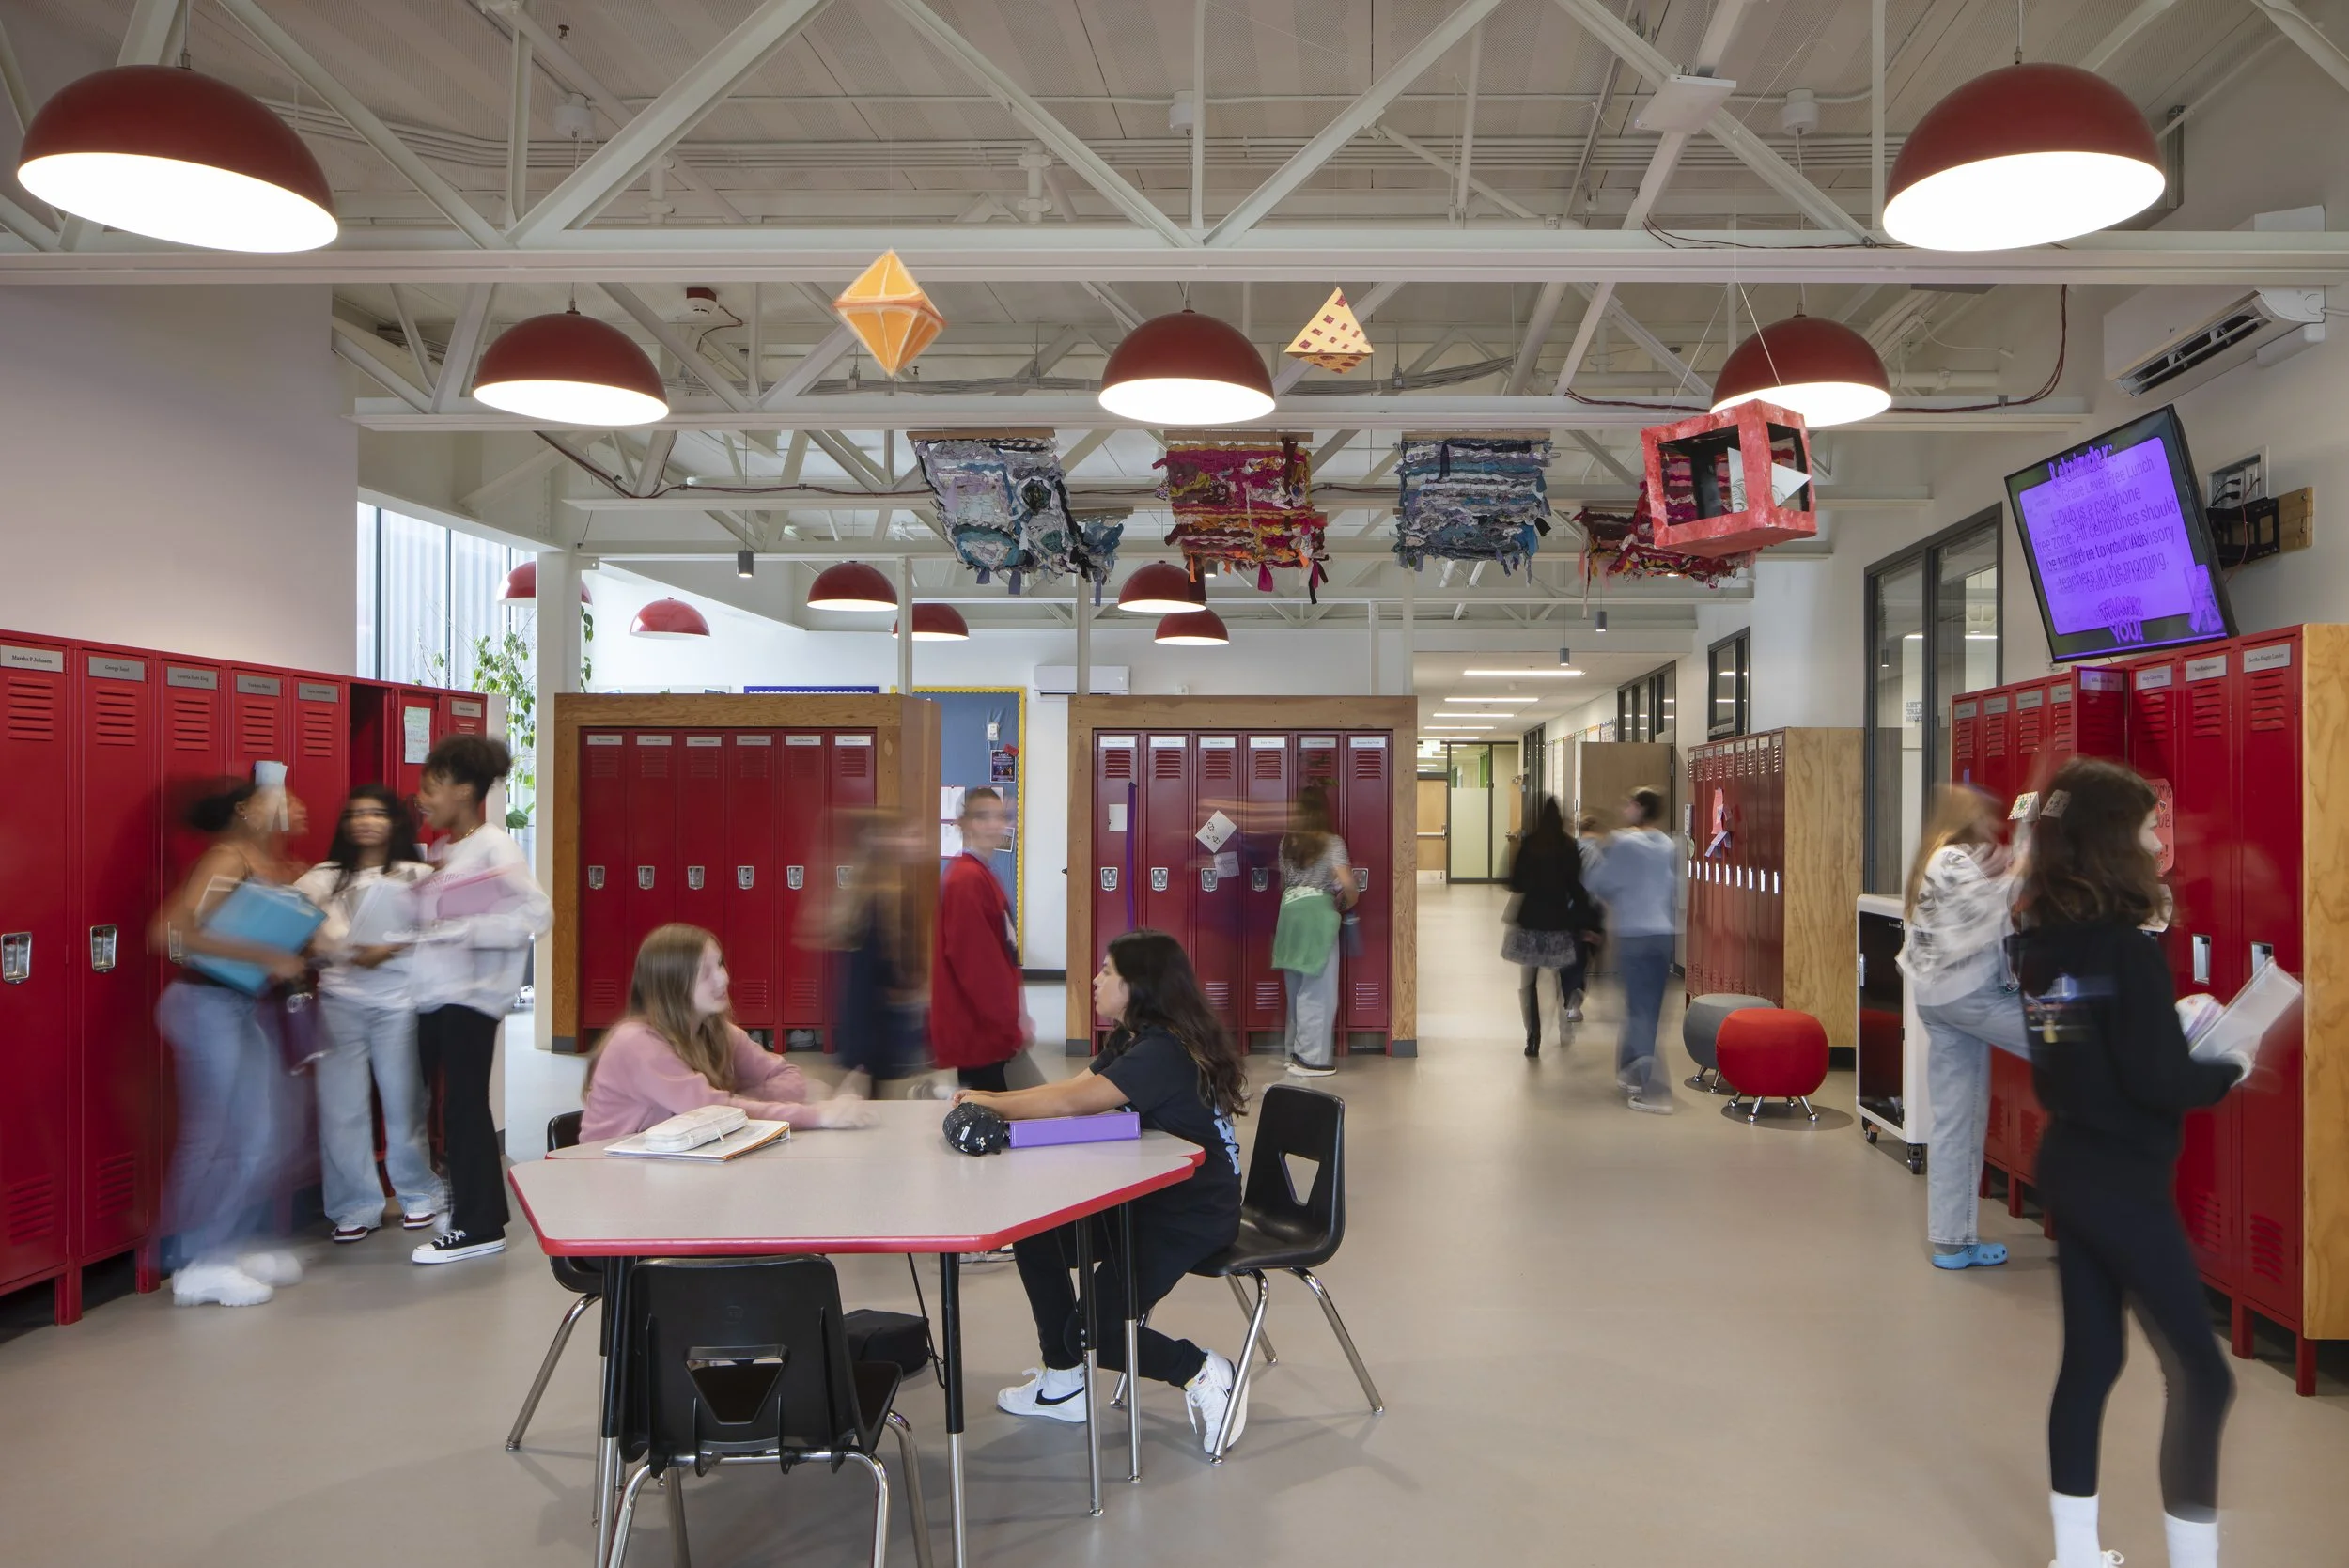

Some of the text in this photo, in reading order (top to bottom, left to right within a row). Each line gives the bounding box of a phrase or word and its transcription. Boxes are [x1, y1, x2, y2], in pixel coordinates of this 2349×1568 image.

[2086, 474, 2106, 494] Level
[2107, 470, 2125, 487] Free
[2126, 455, 2155, 479] Lunch
[2077, 503, 2087, 520] is
[2087, 504, 2093, 517] a
[2094, 486, 2142, 514] cellphone
[2035, 537, 2051, 554] free
[2052, 533, 2076, 549] zone.
[2089, 512, 2139, 538] cellphones
[2140, 496, 2178, 522] should
[2058, 570, 2095, 590] teachers
[2095, 564, 2106, 582] in
[2106, 561, 2122, 579] the
[2123, 551, 2169, 573] morning.
[2108, 620, 2144, 644] YOU!
